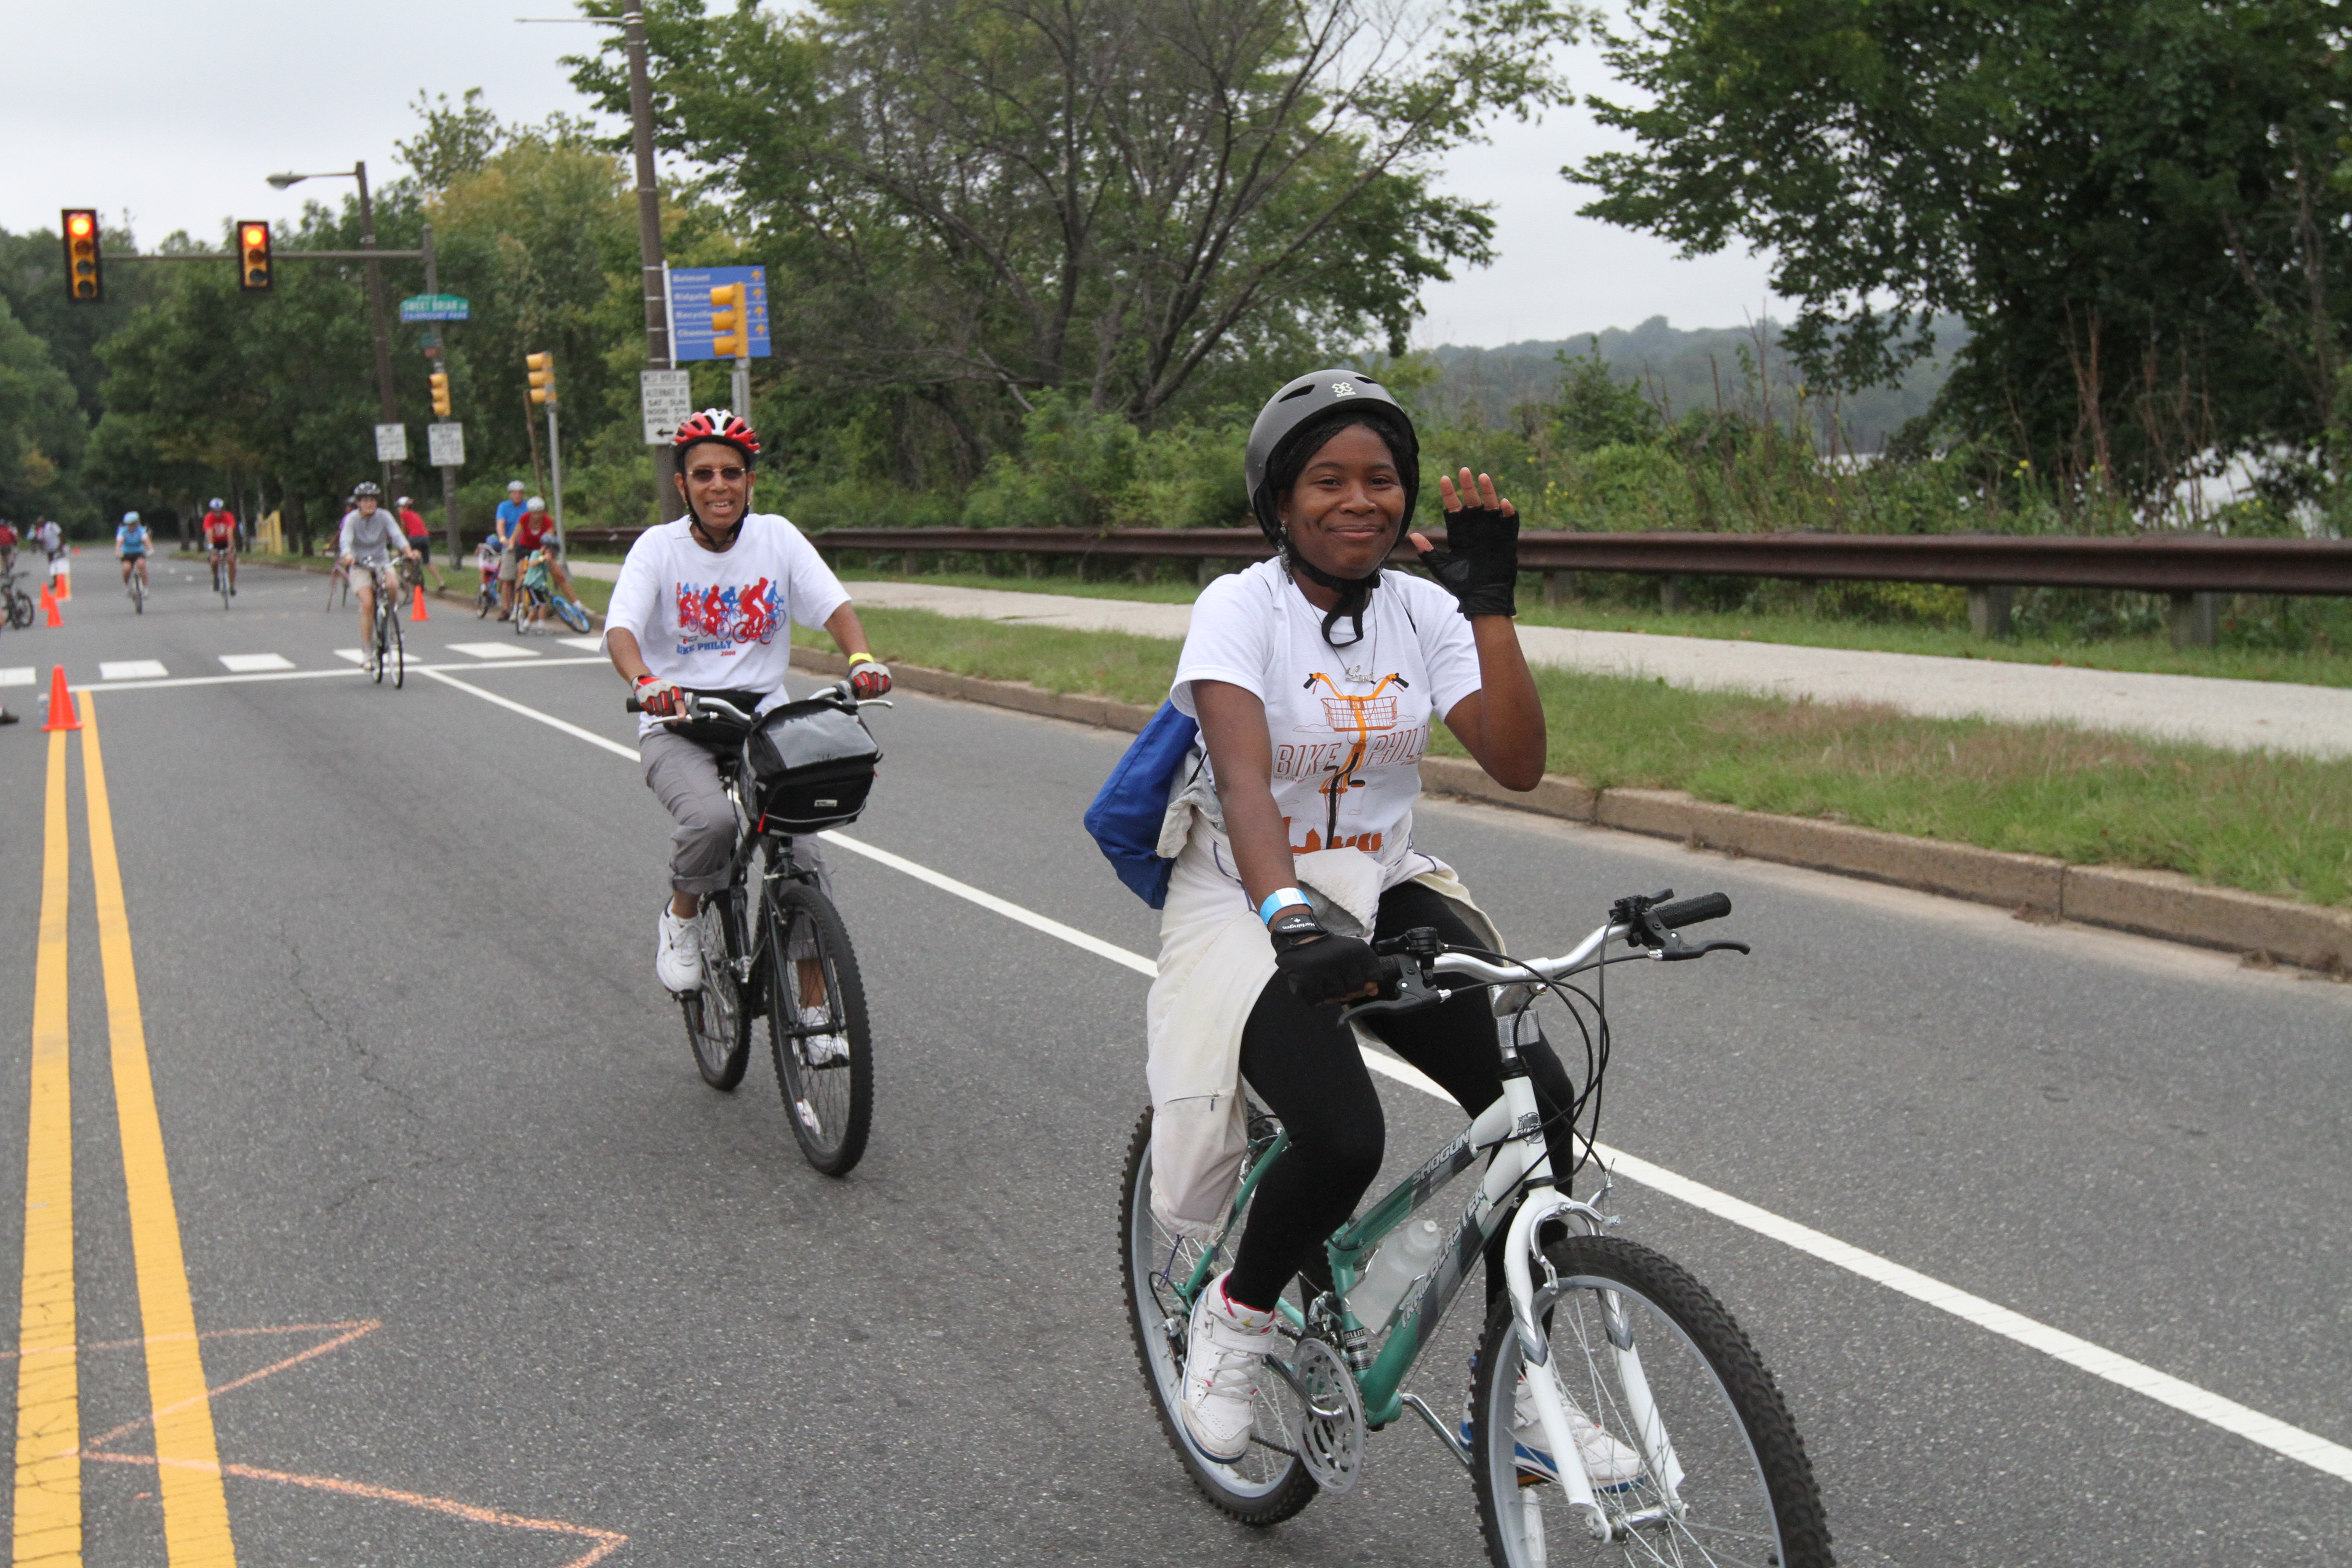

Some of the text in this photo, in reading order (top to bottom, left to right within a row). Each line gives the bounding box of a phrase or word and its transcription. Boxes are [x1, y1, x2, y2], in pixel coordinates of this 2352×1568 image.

[697, 640, 732, 651] PHILLY
[1273, 723, 1430, 779] BIKE PHILL
[1412, 1128, 1471, 1186] SHOGUN
